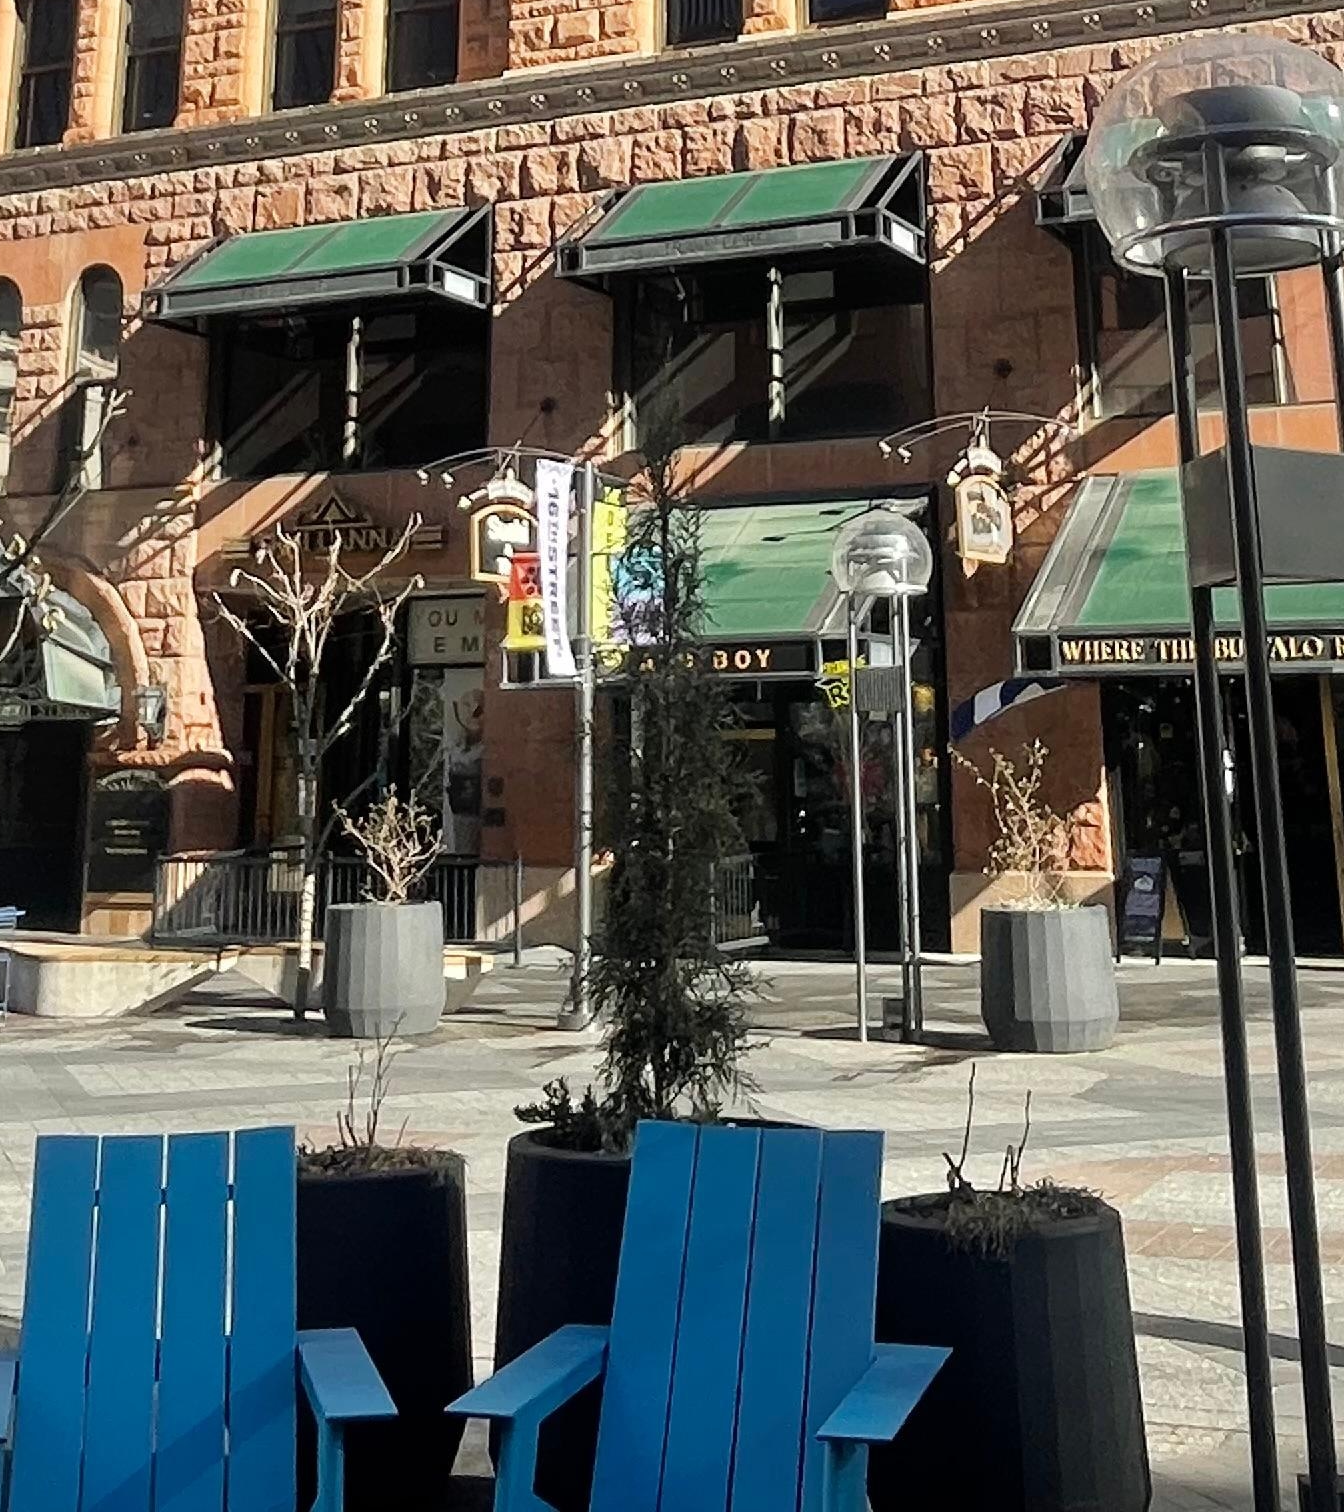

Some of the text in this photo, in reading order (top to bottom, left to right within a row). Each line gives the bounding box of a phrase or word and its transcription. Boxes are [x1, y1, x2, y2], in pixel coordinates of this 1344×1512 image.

[547, 545, 564, 651] STREET
[713, 649, 772, 670] BOY
[1061, 639, 1145, 664] WHERE
[1214, 635, 1324, 663] BUALO
